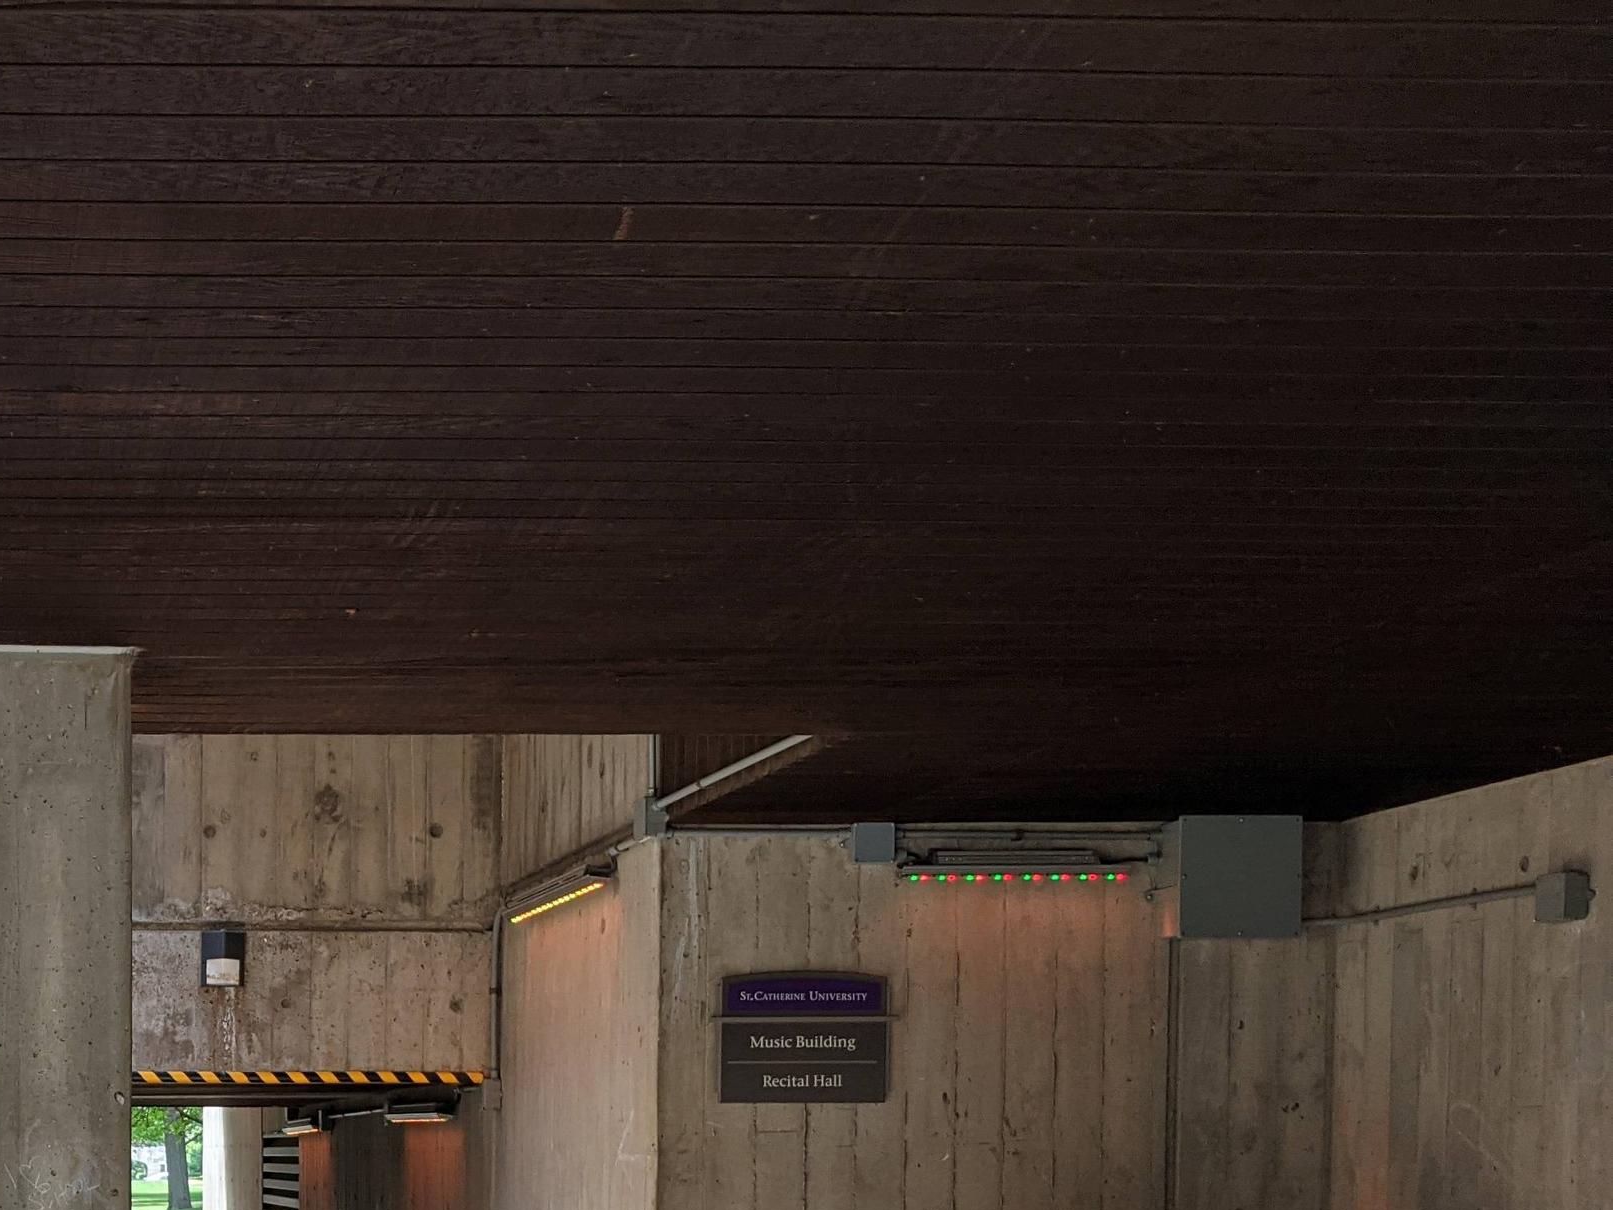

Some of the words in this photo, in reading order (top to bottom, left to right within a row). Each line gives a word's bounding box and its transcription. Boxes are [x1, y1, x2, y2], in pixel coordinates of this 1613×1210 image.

[809, 990, 868, 1001] UNIVERSITY
[749, 1035, 793, 1049] Music
[795, 1035, 856, 1051] Building
[762, 1074, 810, 1088] Recital
[812, 1074, 843, 1088] Hall
